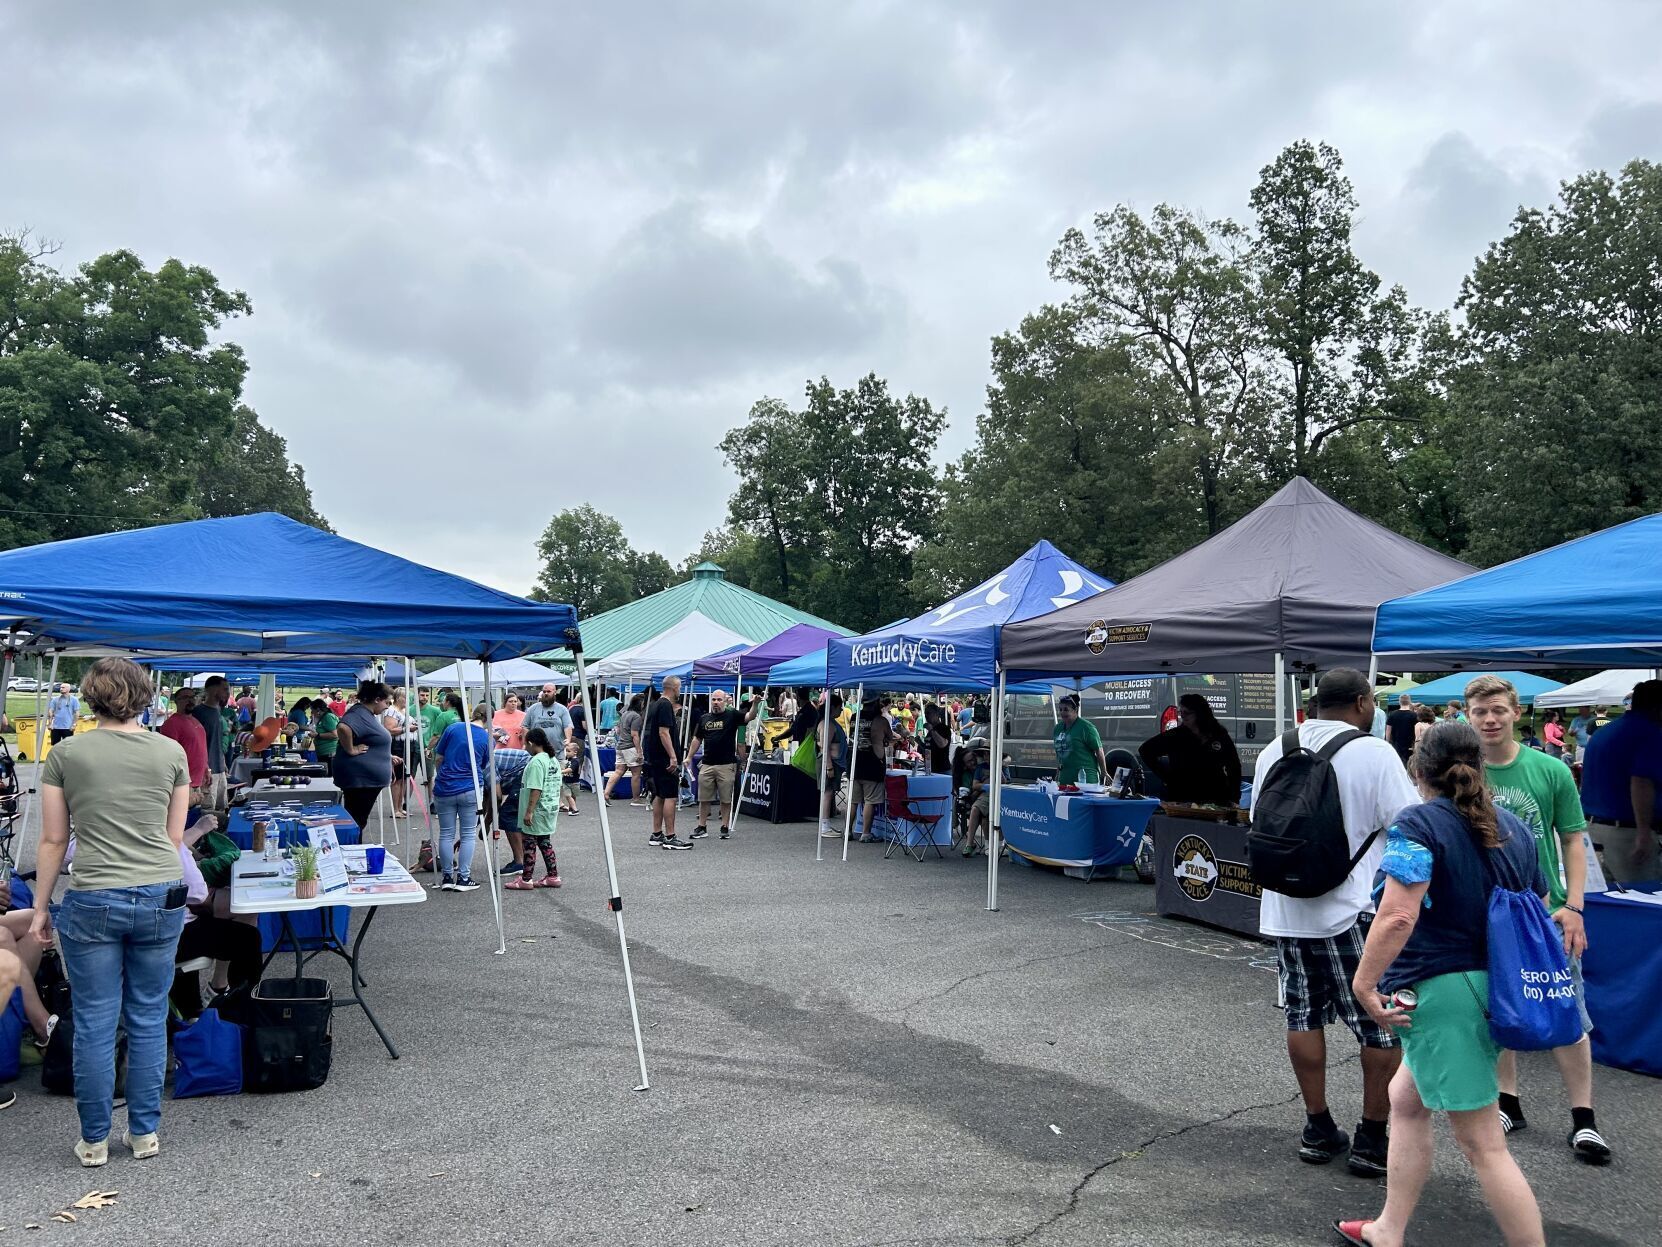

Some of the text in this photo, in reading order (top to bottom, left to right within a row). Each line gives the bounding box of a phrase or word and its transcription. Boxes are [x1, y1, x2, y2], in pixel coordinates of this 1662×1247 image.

[1108, 633, 1146, 642] SUPPORT SERVICES
[851, 638, 956, 668] KentuckyCare
[1104, 690, 1151, 700] TO RECOVERY
[750, 773, 770, 796] BHG
[1004, 806, 1048, 824] KentuckyCare
[1177, 838, 1212, 859] KENTUCKY
[1184, 863, 1209, 879] STATE
[1219, 863, 1248, 879] VICTIM
[1183, 879, 1210, 897] POLICE
[1219, 876, 1255, 895] SUPPORT
